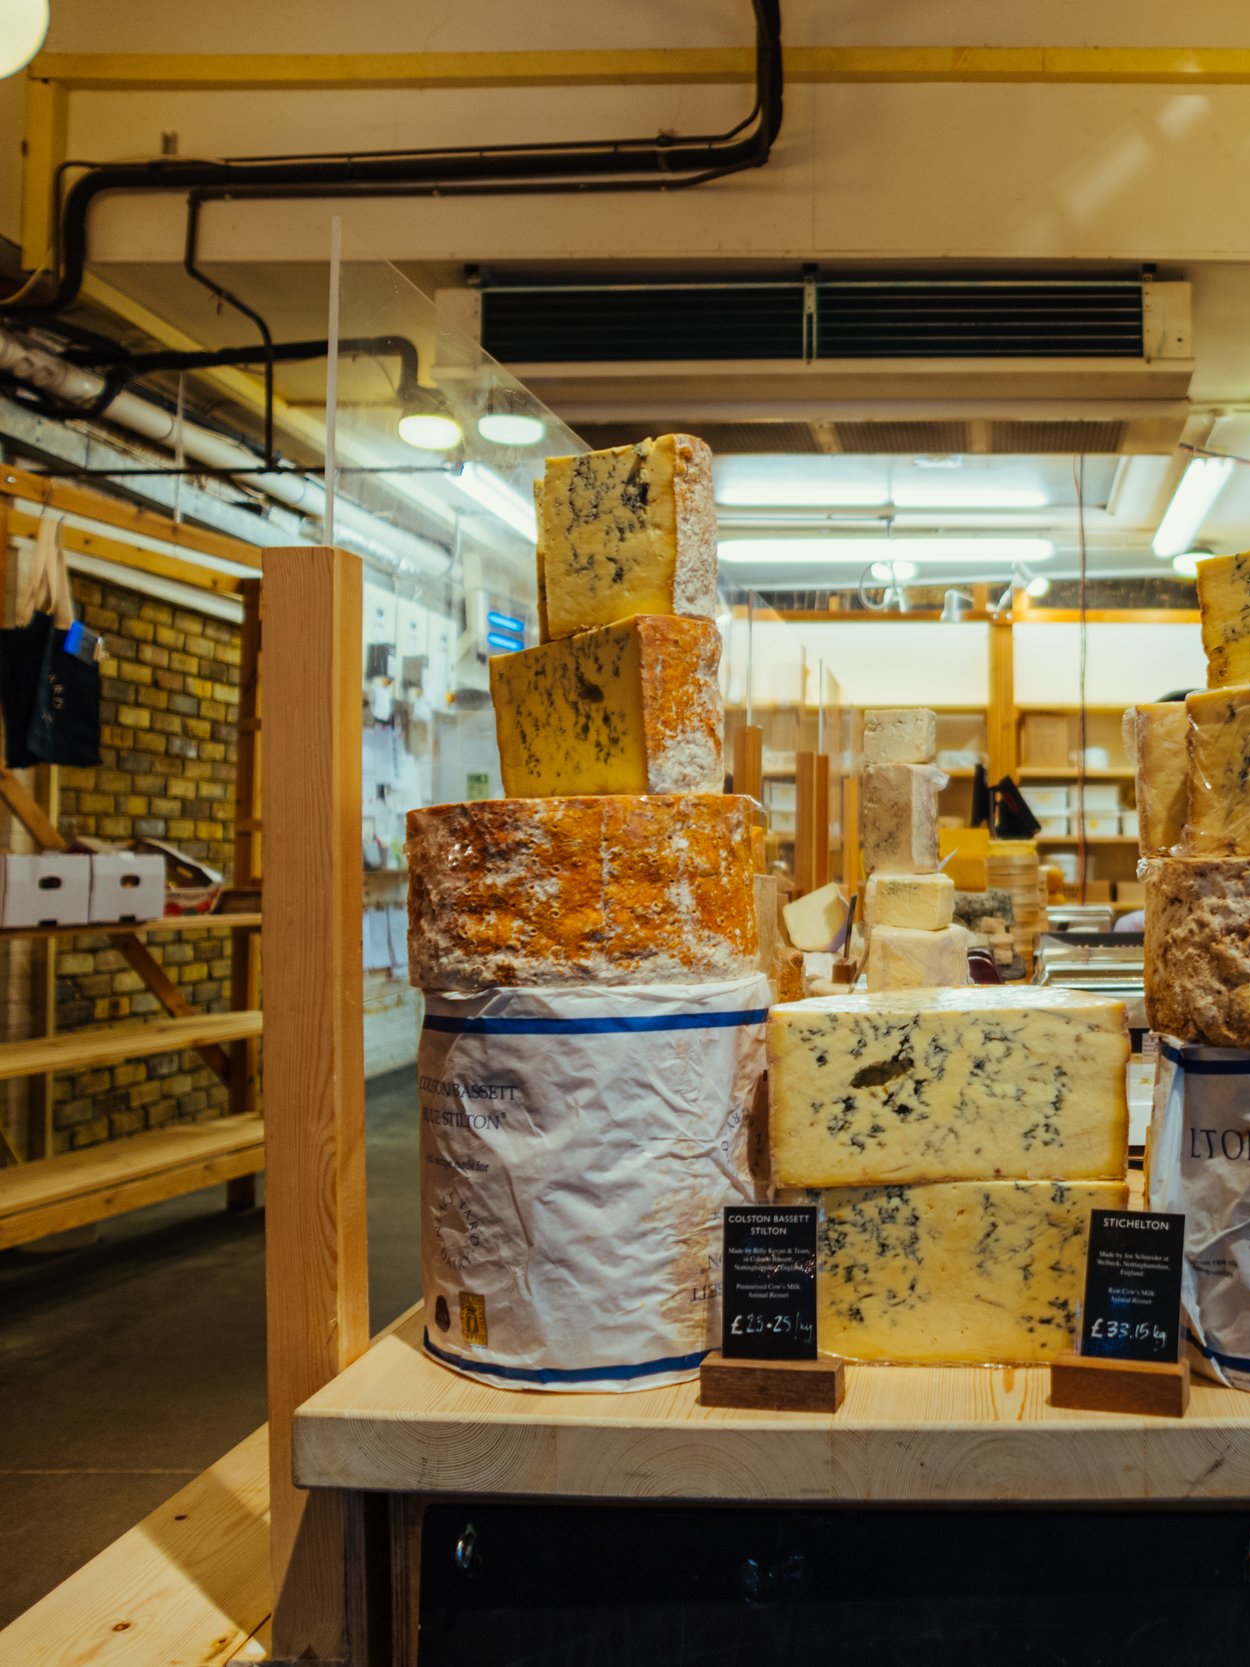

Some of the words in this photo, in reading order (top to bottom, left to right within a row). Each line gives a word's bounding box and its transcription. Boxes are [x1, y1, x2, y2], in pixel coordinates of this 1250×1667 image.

[453, 1083, 518, 1100] BASSETT
[728, 1214, 772, 1224] COLSTON
[773, 1214, 811, 1224] BASSETT
[1103, 1218, 1170, 1231] STICHELTON
[750, 1226, 788, 1236] STILTON
